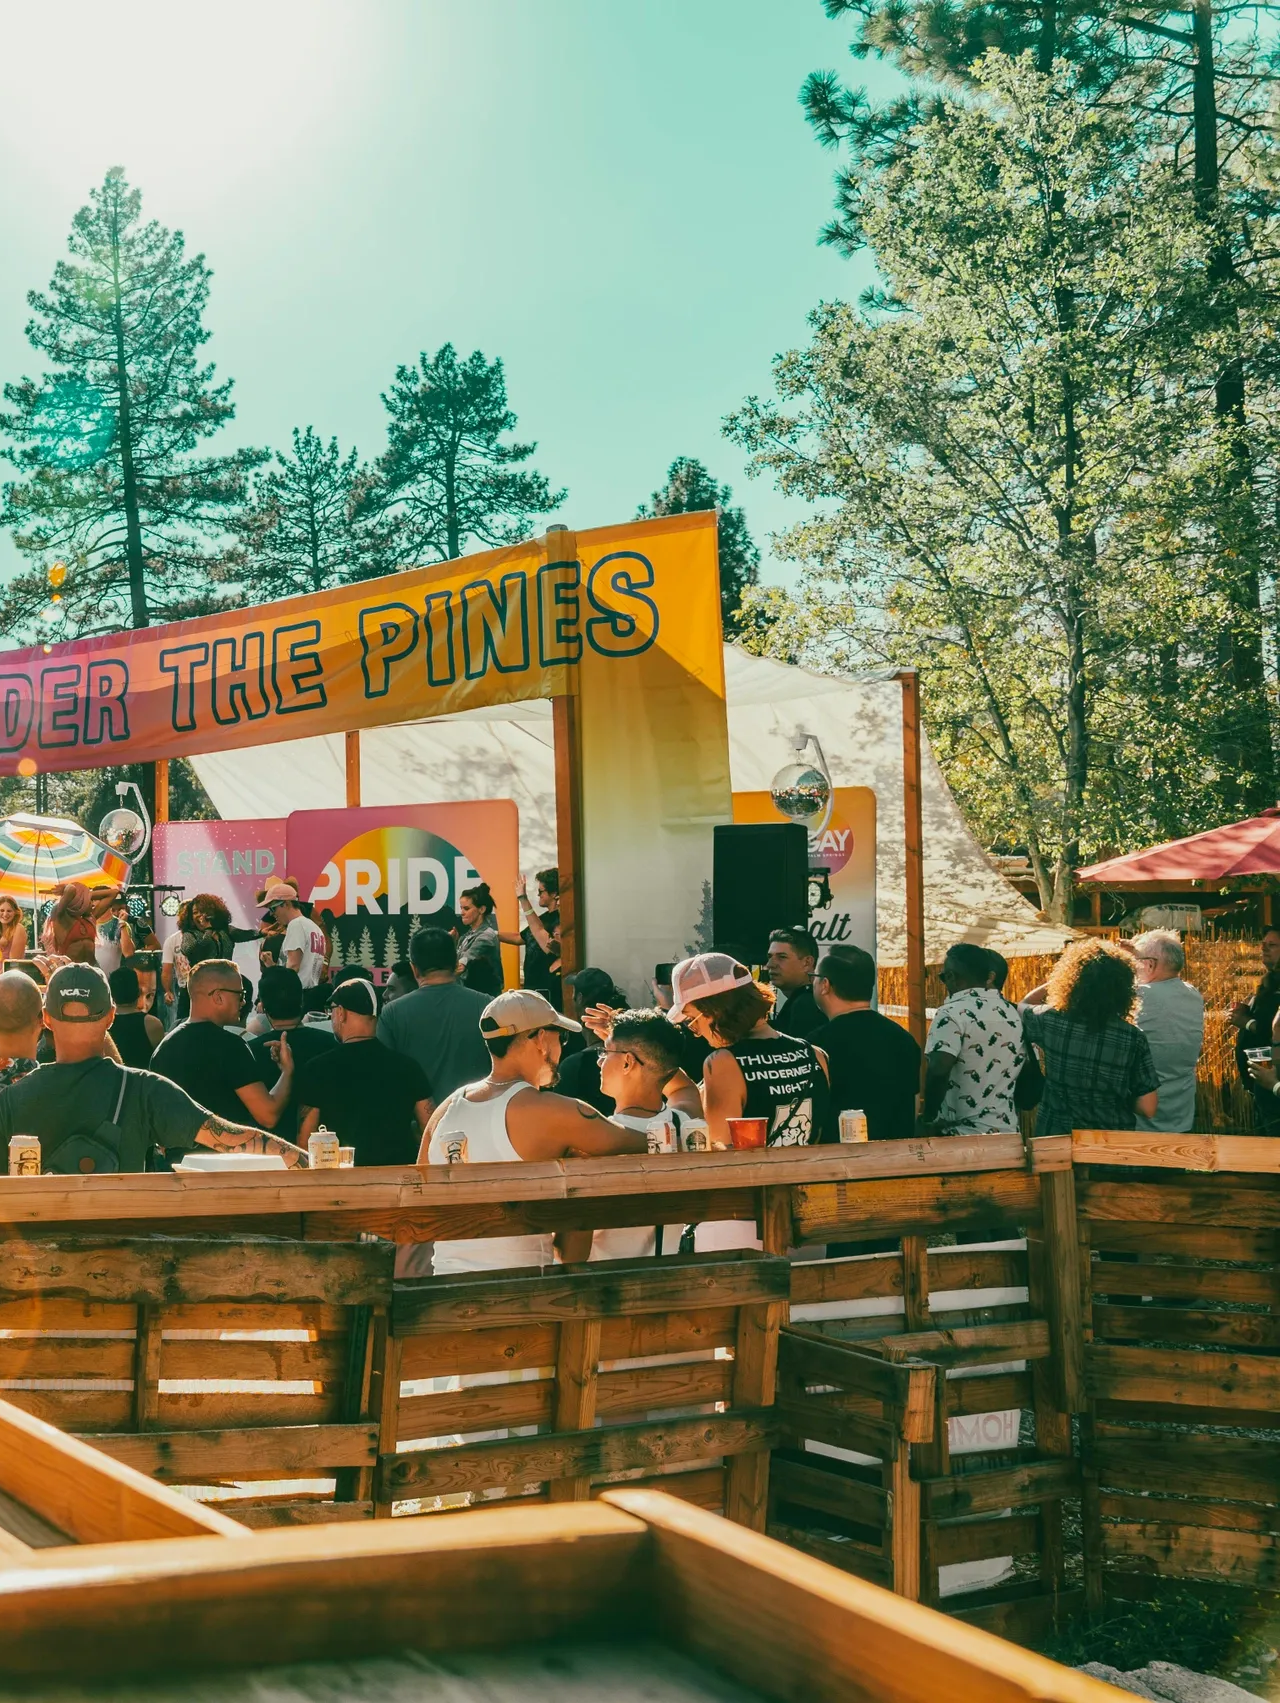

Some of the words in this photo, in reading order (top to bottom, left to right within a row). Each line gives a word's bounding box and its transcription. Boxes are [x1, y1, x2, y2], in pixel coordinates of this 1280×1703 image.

[160, 619, 328, 732] THE
[359, 551, 659, 699] PINES
[808, 829, 850, 852] GAY
[177, 849, 276, 876] STAND
[809, 913, 852, 941] alt
[735, 1048, 810, 1066] THURSDAY
[769, 1080, 813, 1095] NIGHT
